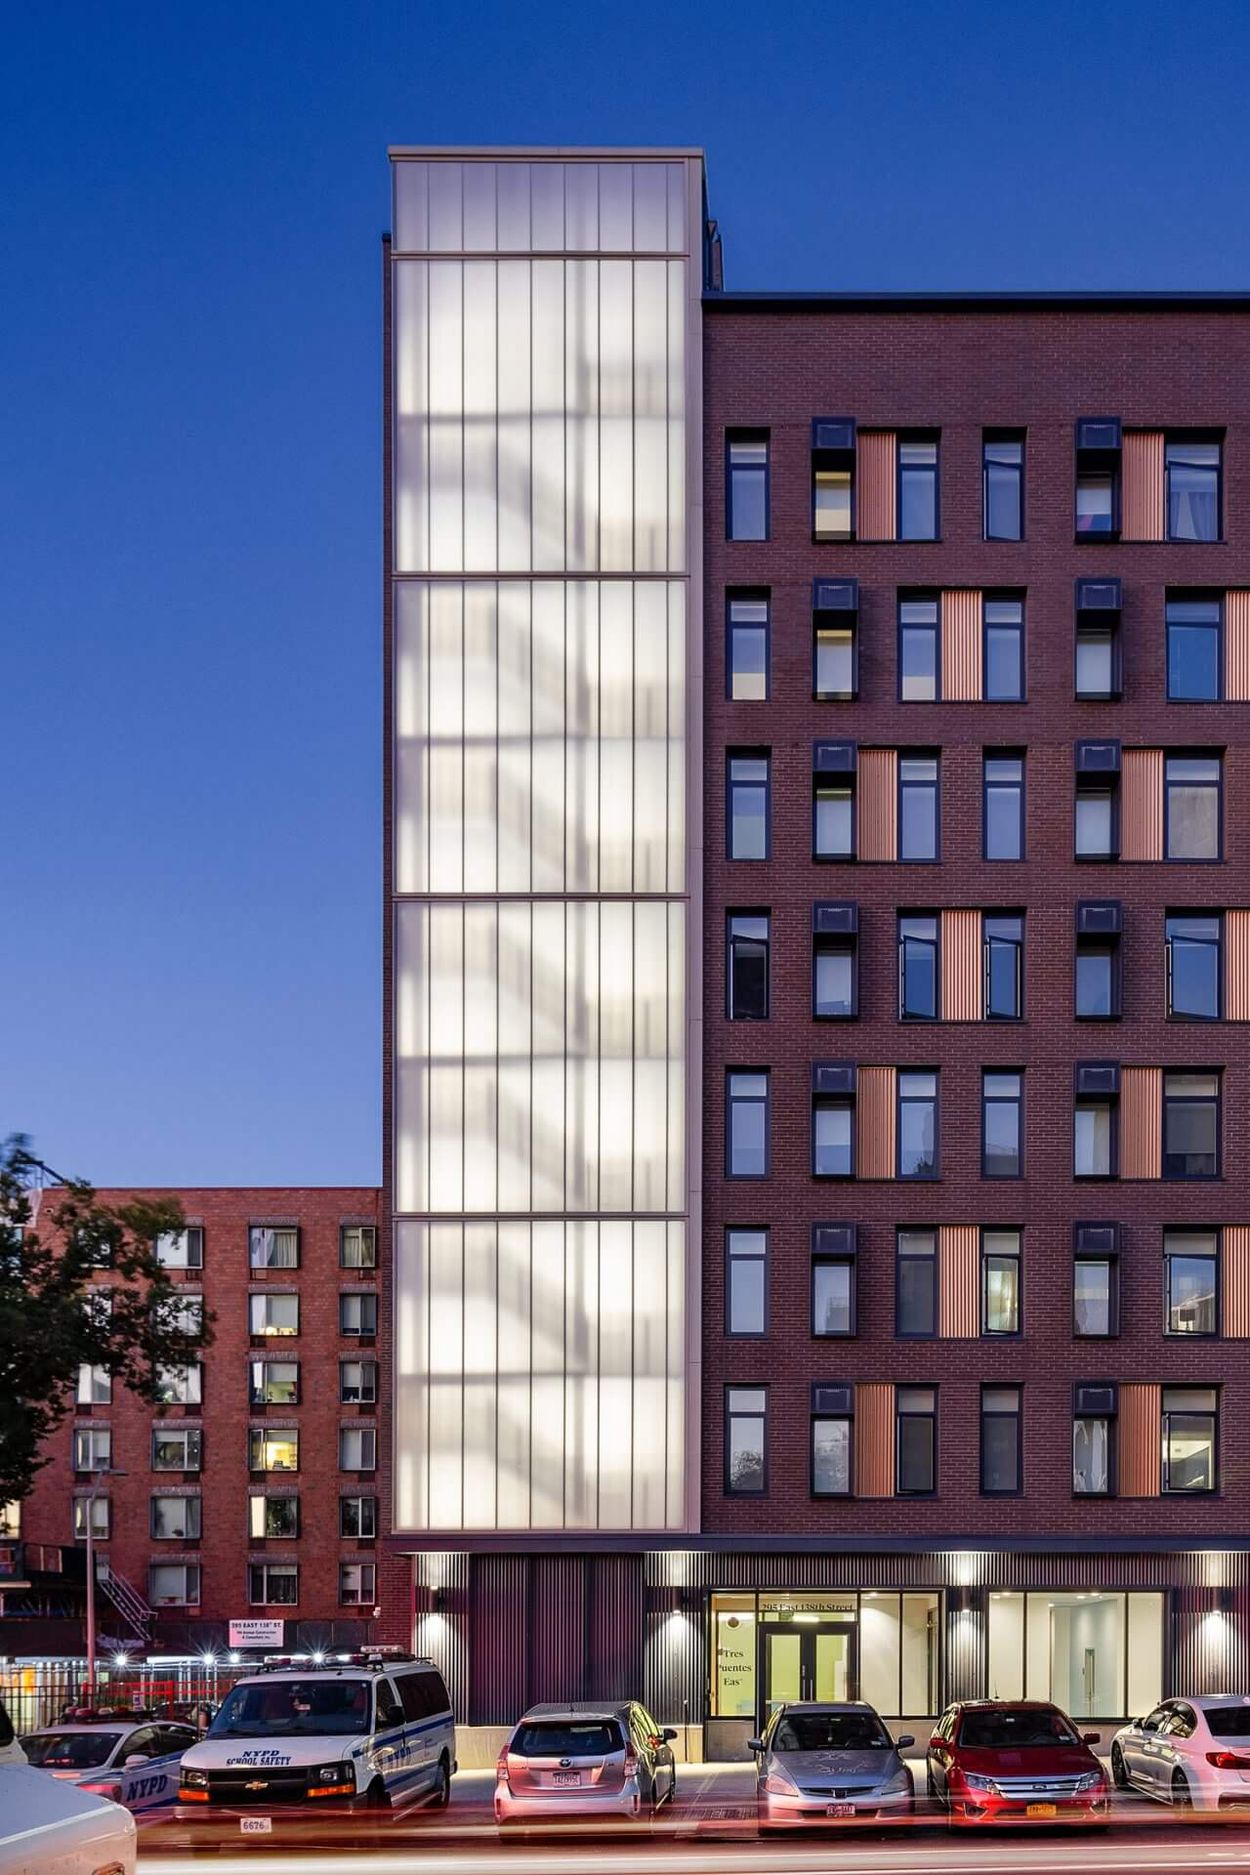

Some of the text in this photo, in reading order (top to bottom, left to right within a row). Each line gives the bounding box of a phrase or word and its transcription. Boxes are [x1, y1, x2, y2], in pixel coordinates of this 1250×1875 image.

[780, 1603, 799, 1612] East
[827, 1603, 853, 1611] Street
[723, 1649, 744, 1658] Tres
[719, 1664, 752, 1672] uentes
[724, 1678, 743, 1686] Eas
[226, 1756, 292, 1766] SCHOOL SAFETY
[127, 1774, 168, 1802] NYPD
